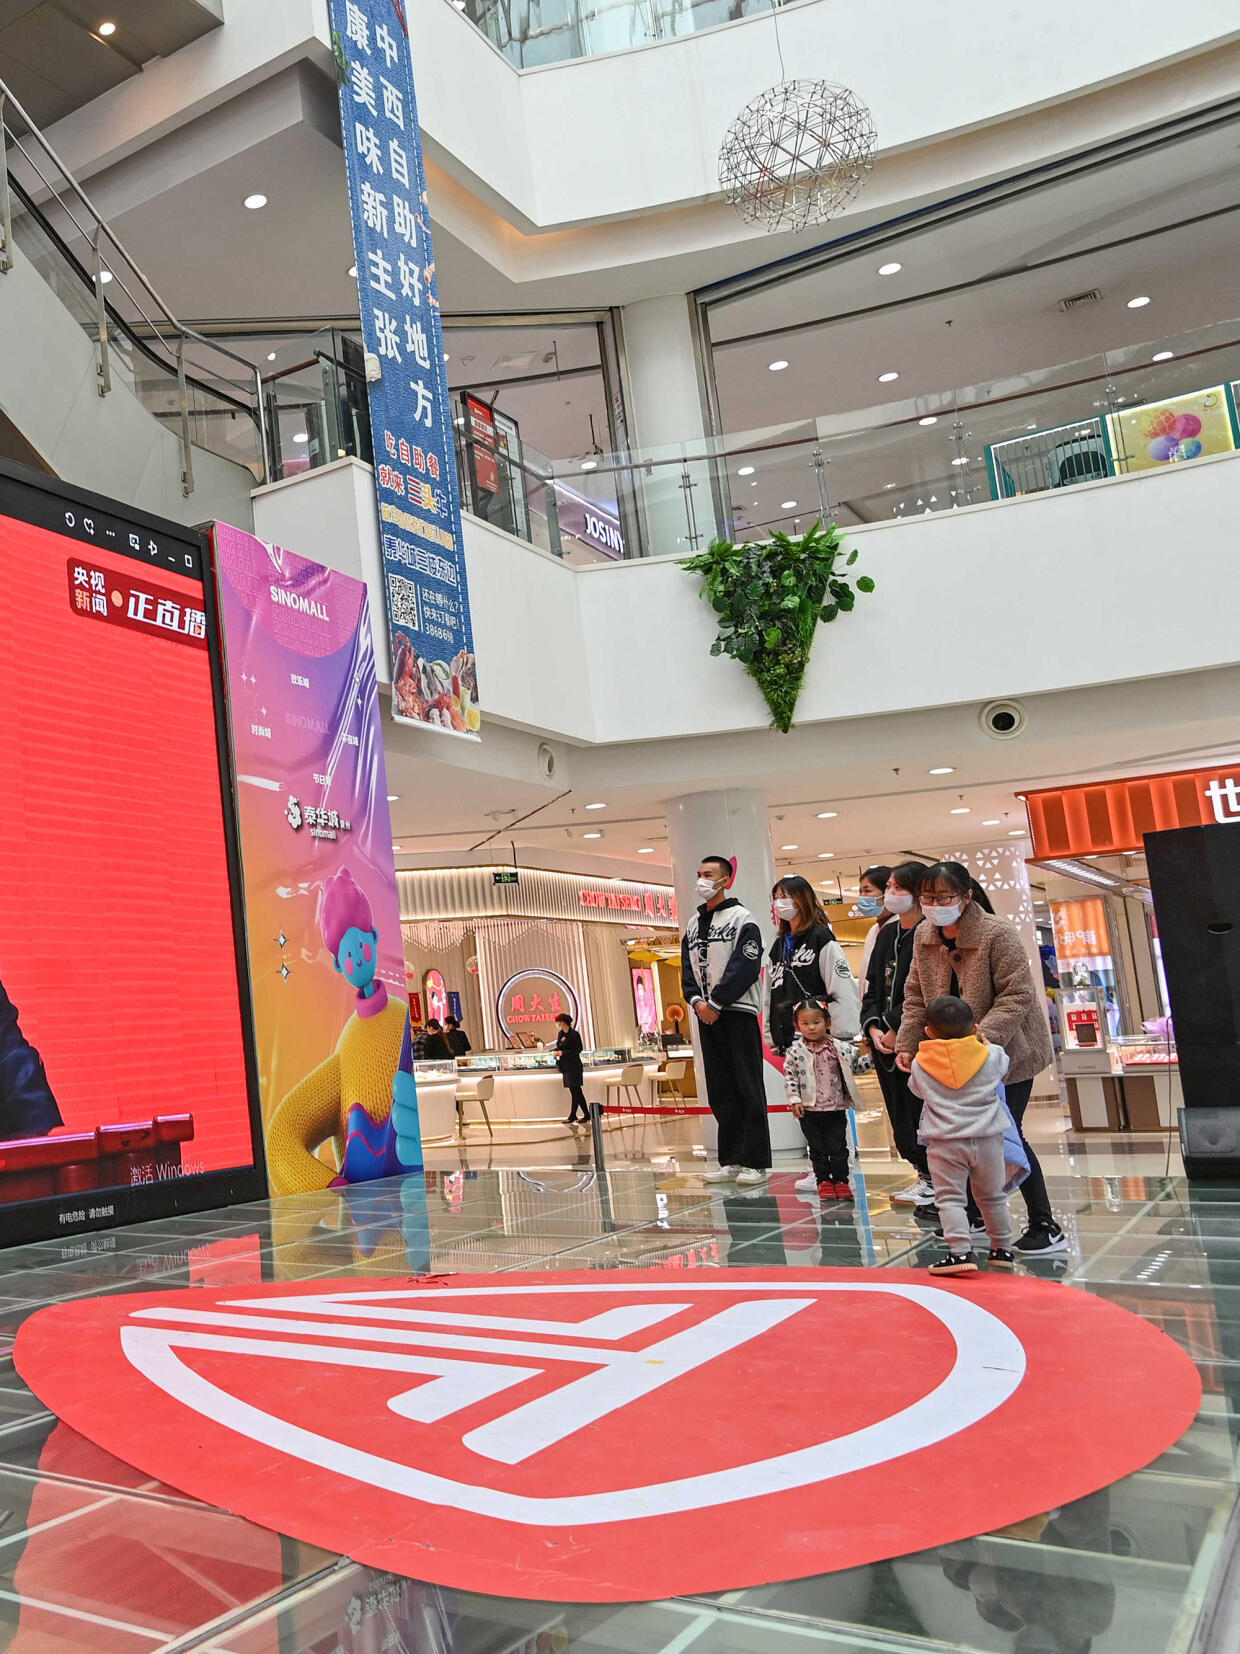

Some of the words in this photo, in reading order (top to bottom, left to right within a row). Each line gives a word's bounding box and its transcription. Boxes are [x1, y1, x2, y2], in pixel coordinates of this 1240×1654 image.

[346, 0, 402, 364] 康美味新主张
[375, 24, 433, 428] 中西自助好地方
[384, 430, 440, 480] 吃自助餐
[73, 566, 106, 593] 央视
[75, 589, 108, 616] 新闻
[269, 585, 329, 622] SINOMALL
[304, 806, 339, 828] 泰华城
[130, 1163, 154, 1187] 激活
[156, 1161, 204, 1180] Windows
[59, 1210, 85, 1224] 有电危险
[89, 1205, 114, 1219] 请勿触摸
